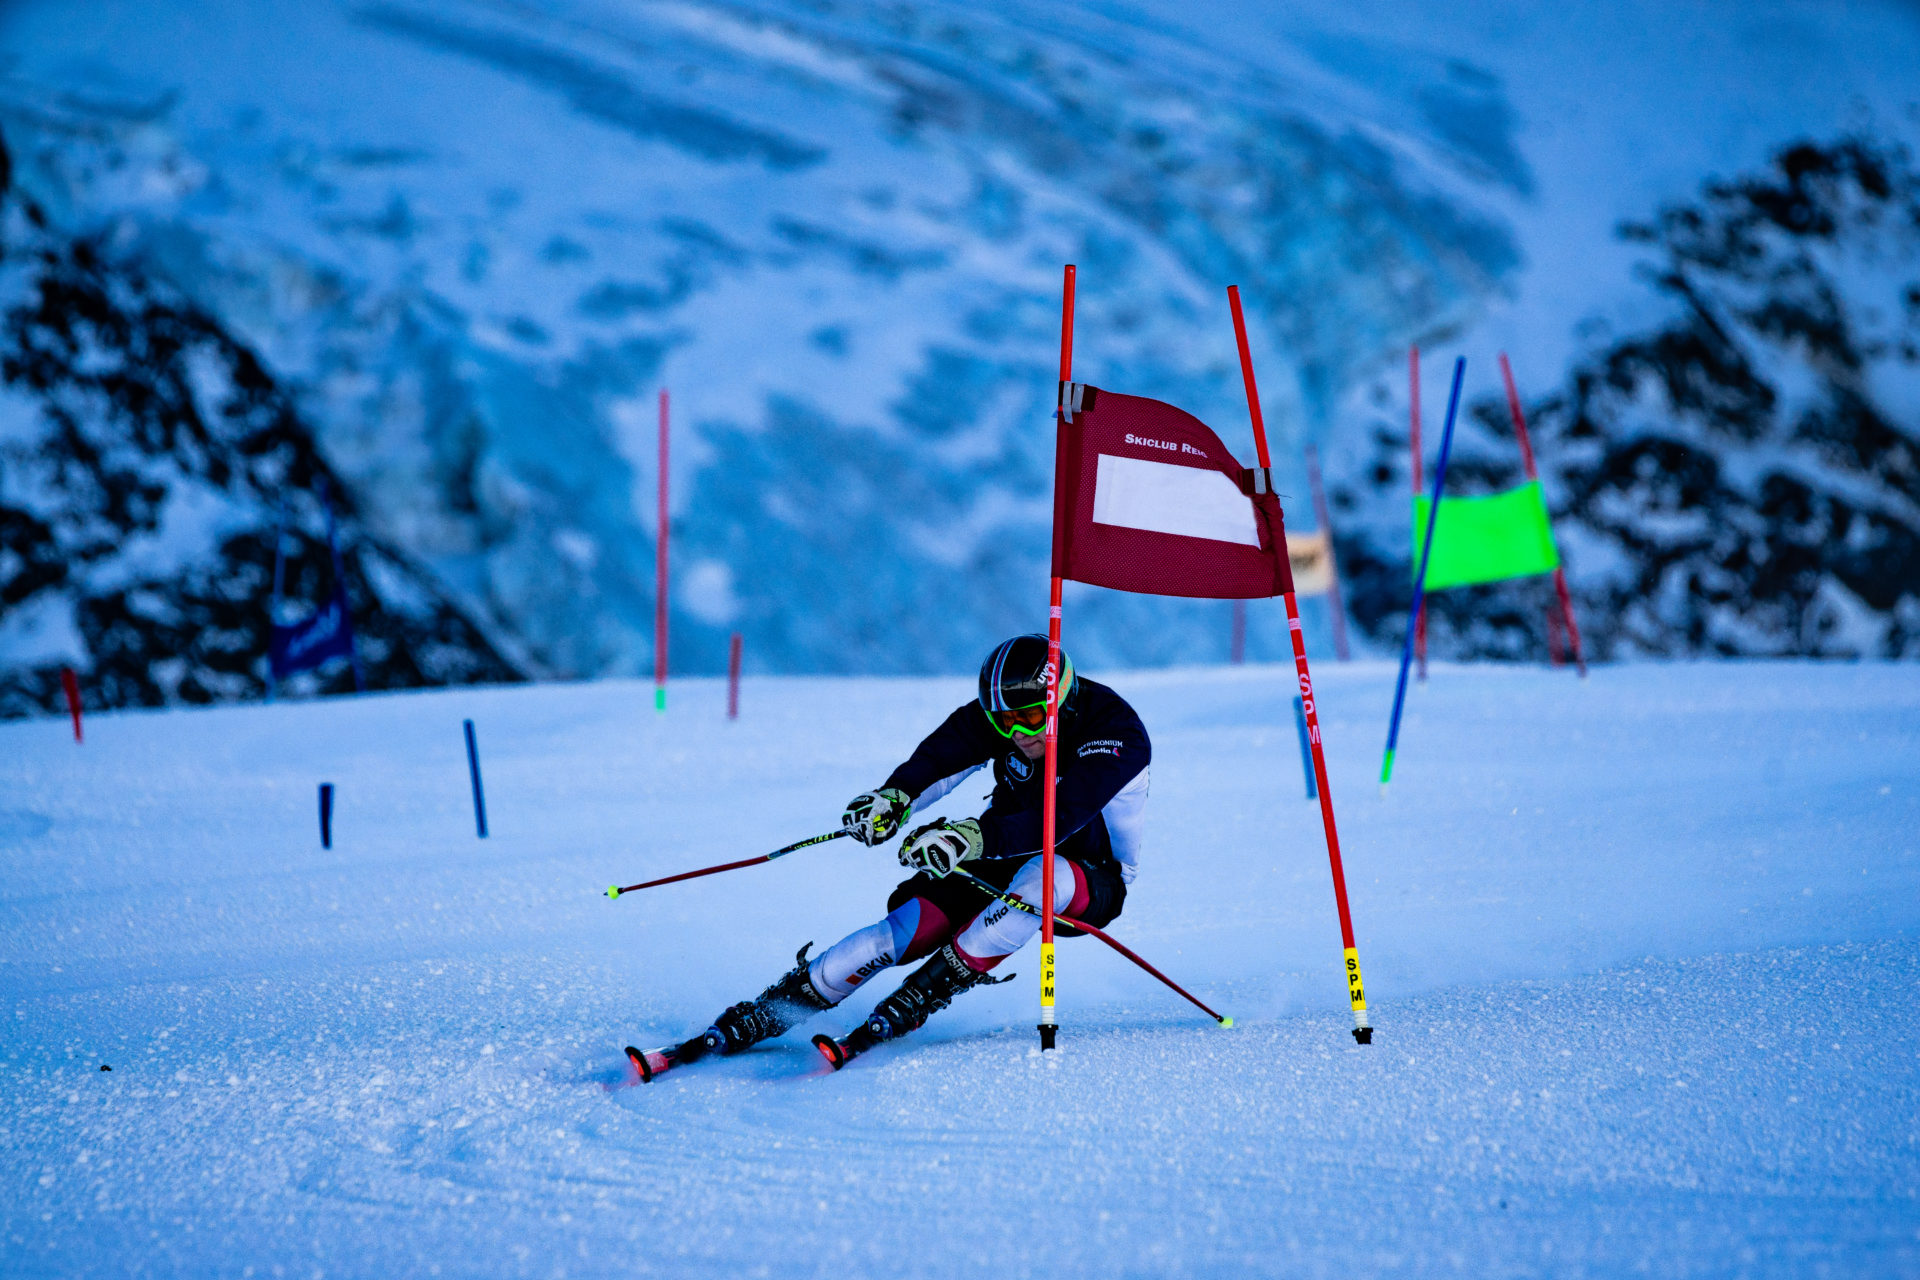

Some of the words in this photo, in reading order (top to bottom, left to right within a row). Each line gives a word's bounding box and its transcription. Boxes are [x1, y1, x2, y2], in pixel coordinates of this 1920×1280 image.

[1000, 894, 1030, 912] LEKI
[856, 952, 894, 977] BKW
[1346, 958, 1363, 1002] SPM
